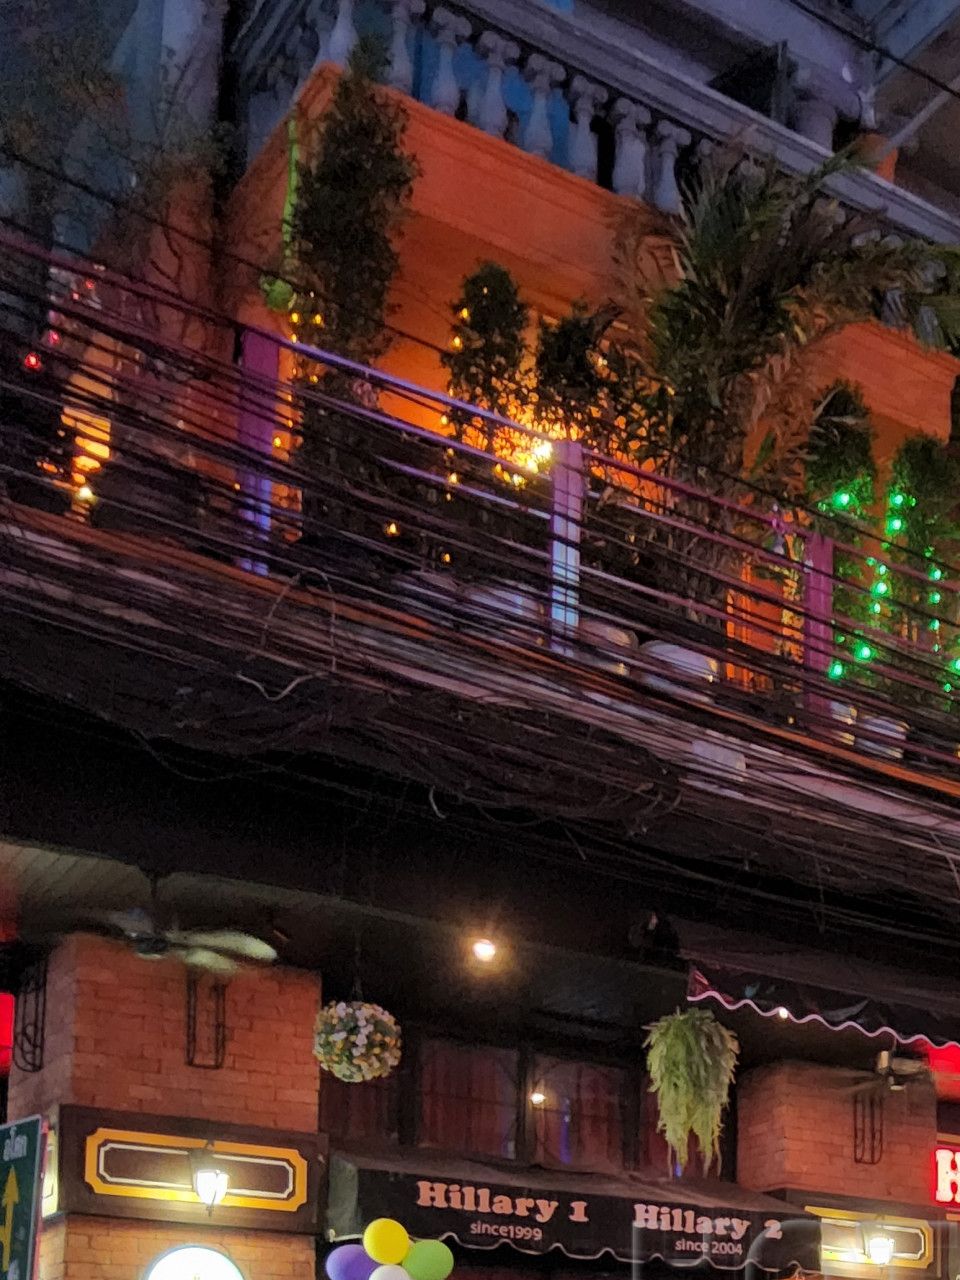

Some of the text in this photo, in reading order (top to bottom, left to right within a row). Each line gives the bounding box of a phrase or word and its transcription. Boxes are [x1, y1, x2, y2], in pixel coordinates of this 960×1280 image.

[416, 1180, 589, 1222] Hillary 1
[470, 1220, 543, 1241] since1999
[634, 1203, 783, 1239] Hillary 2
[675, 1238, 743, 1256] since 2004
